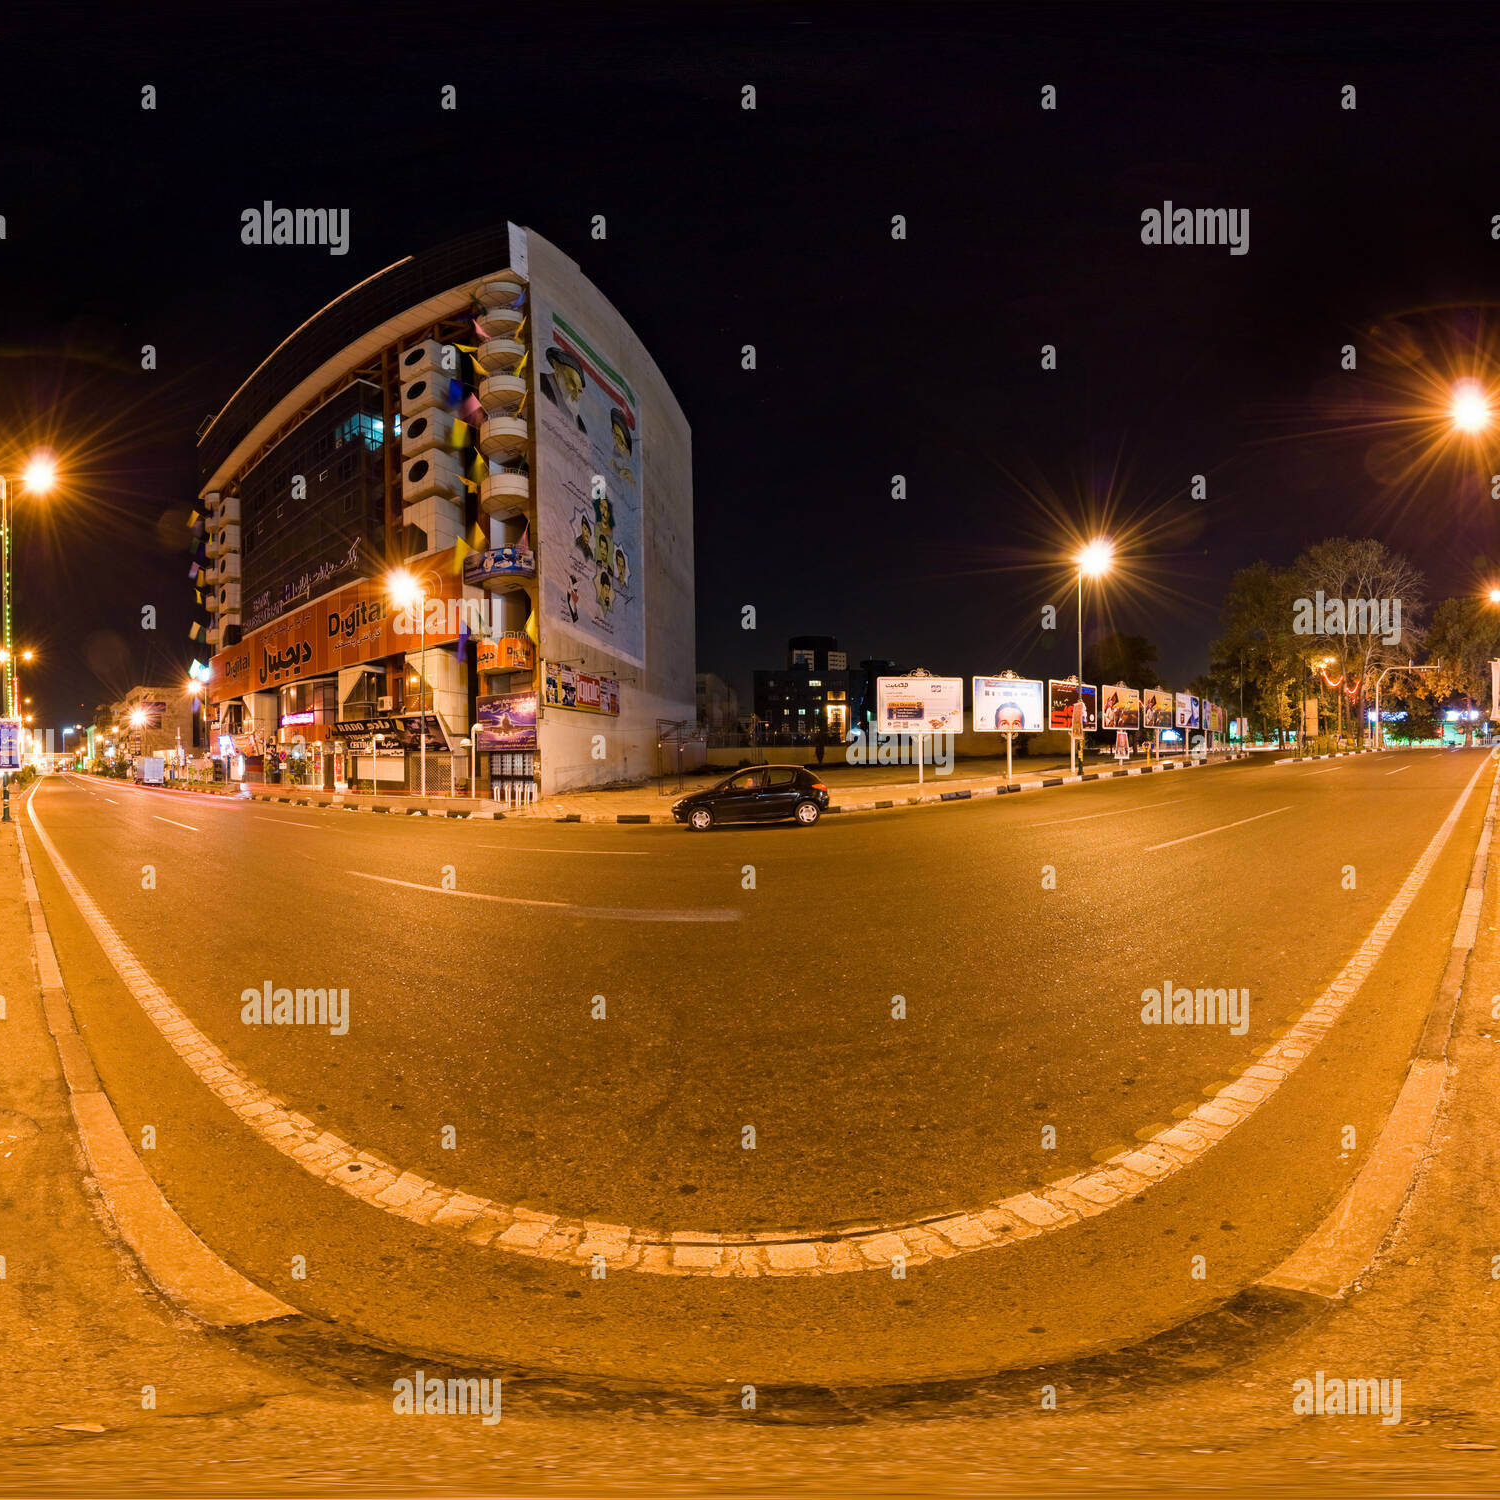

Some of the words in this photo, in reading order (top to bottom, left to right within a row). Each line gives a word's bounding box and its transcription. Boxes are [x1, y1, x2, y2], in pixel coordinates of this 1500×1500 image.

[328, 594, 387, 638] Digital
[225, 652, 251, 678] Digital
[259, 640, 312, 684] دیجیتال
[337, 722, 364, 732] RADO
